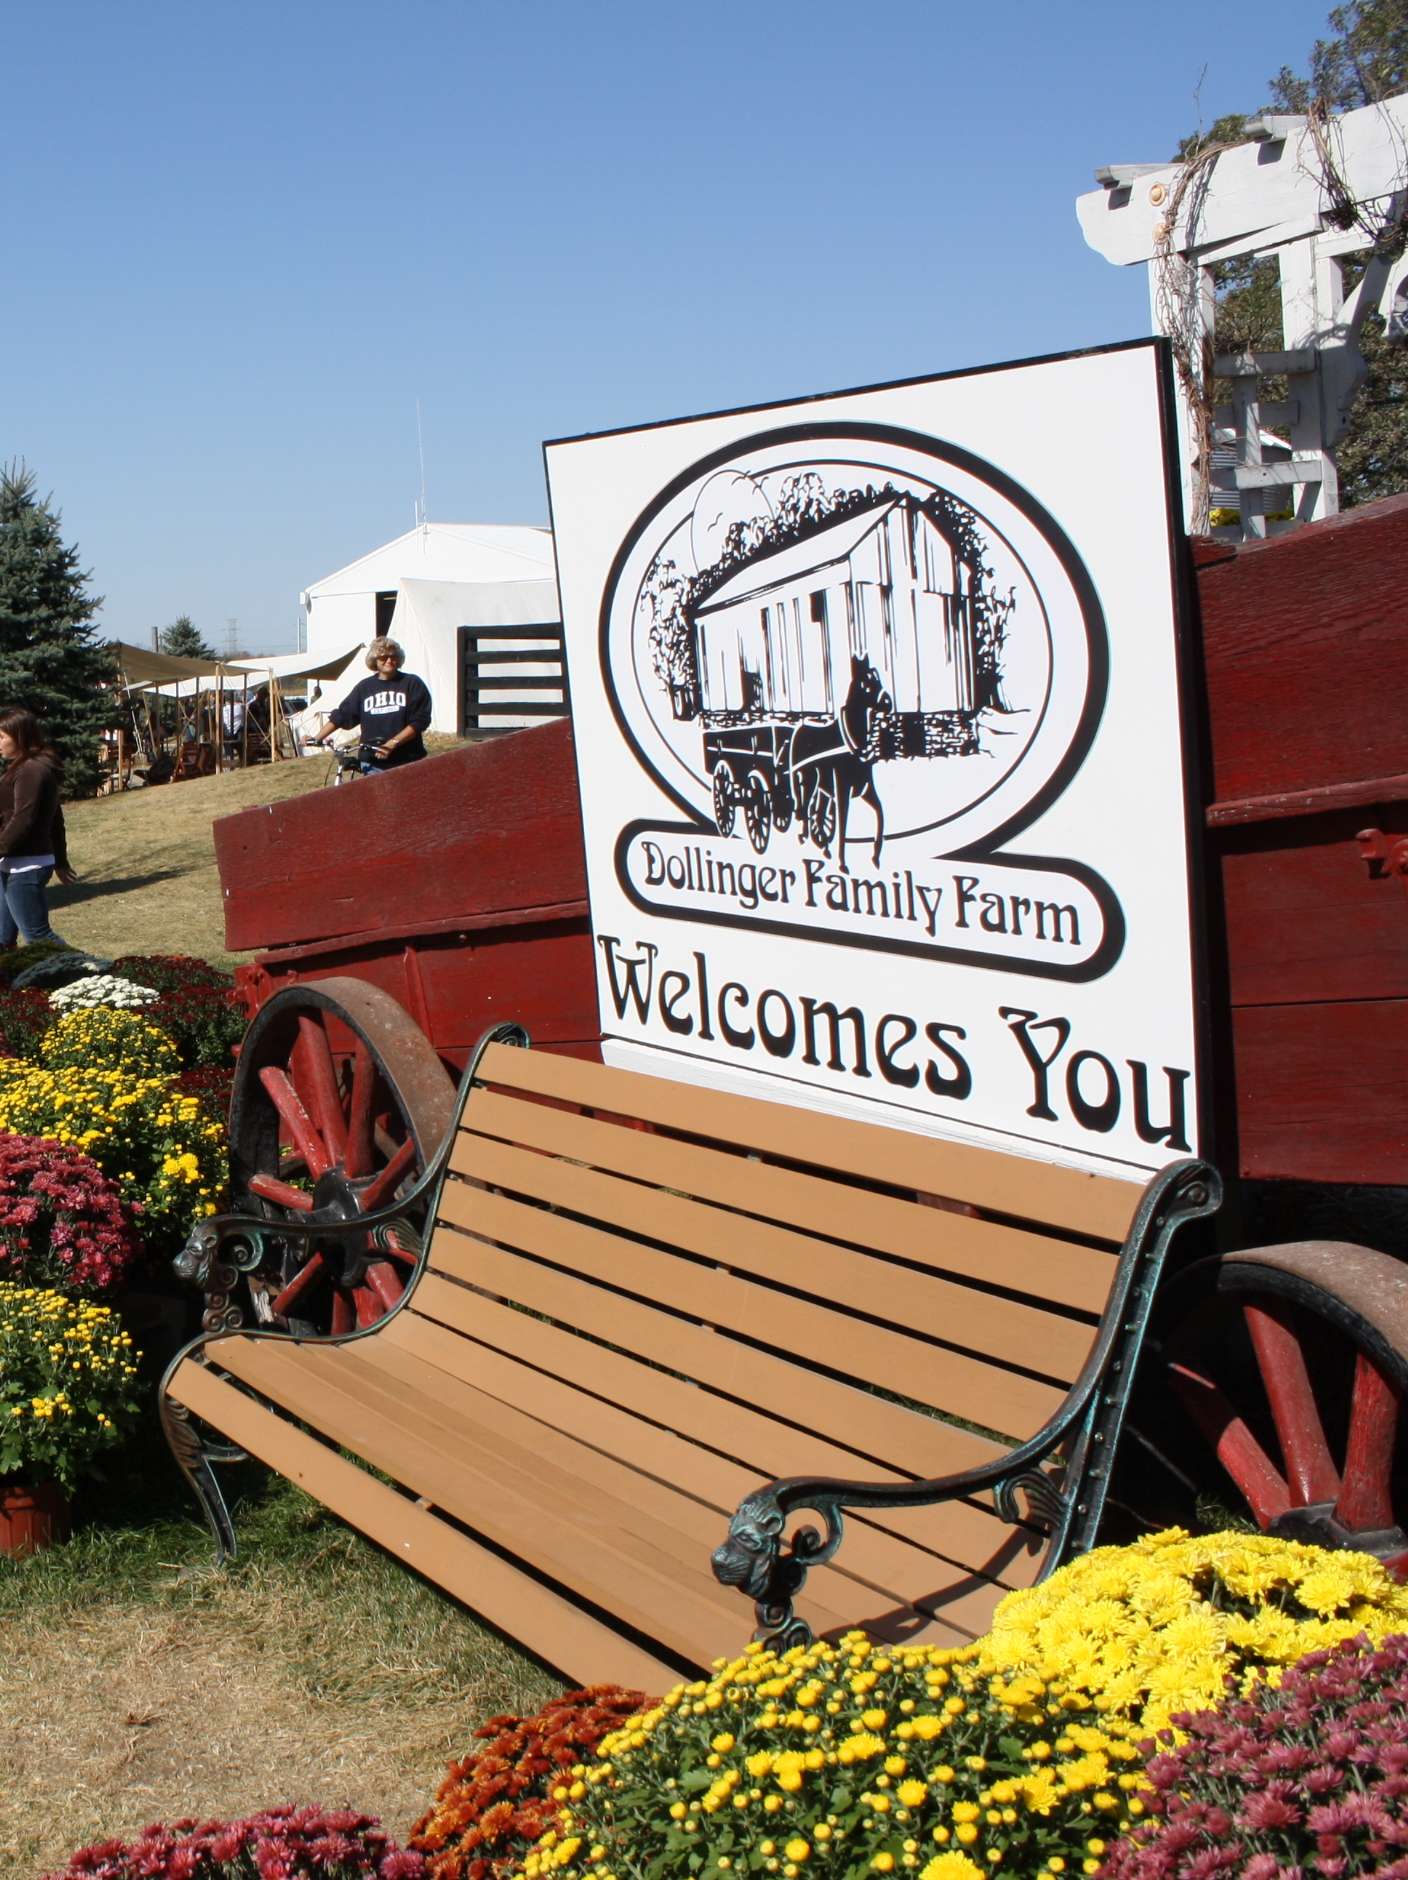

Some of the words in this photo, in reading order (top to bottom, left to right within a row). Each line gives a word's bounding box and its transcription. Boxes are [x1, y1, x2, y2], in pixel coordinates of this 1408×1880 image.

[363, 690, 406, 712] OHIO
[641, 841, 796, 910] Dollinger
[802, 858, 943, 937] Family
[953, 875, 1081, 946] Farm
[596, 934, 972, 1101] Welcomes
[998, 1006, 1192, 1153] You
